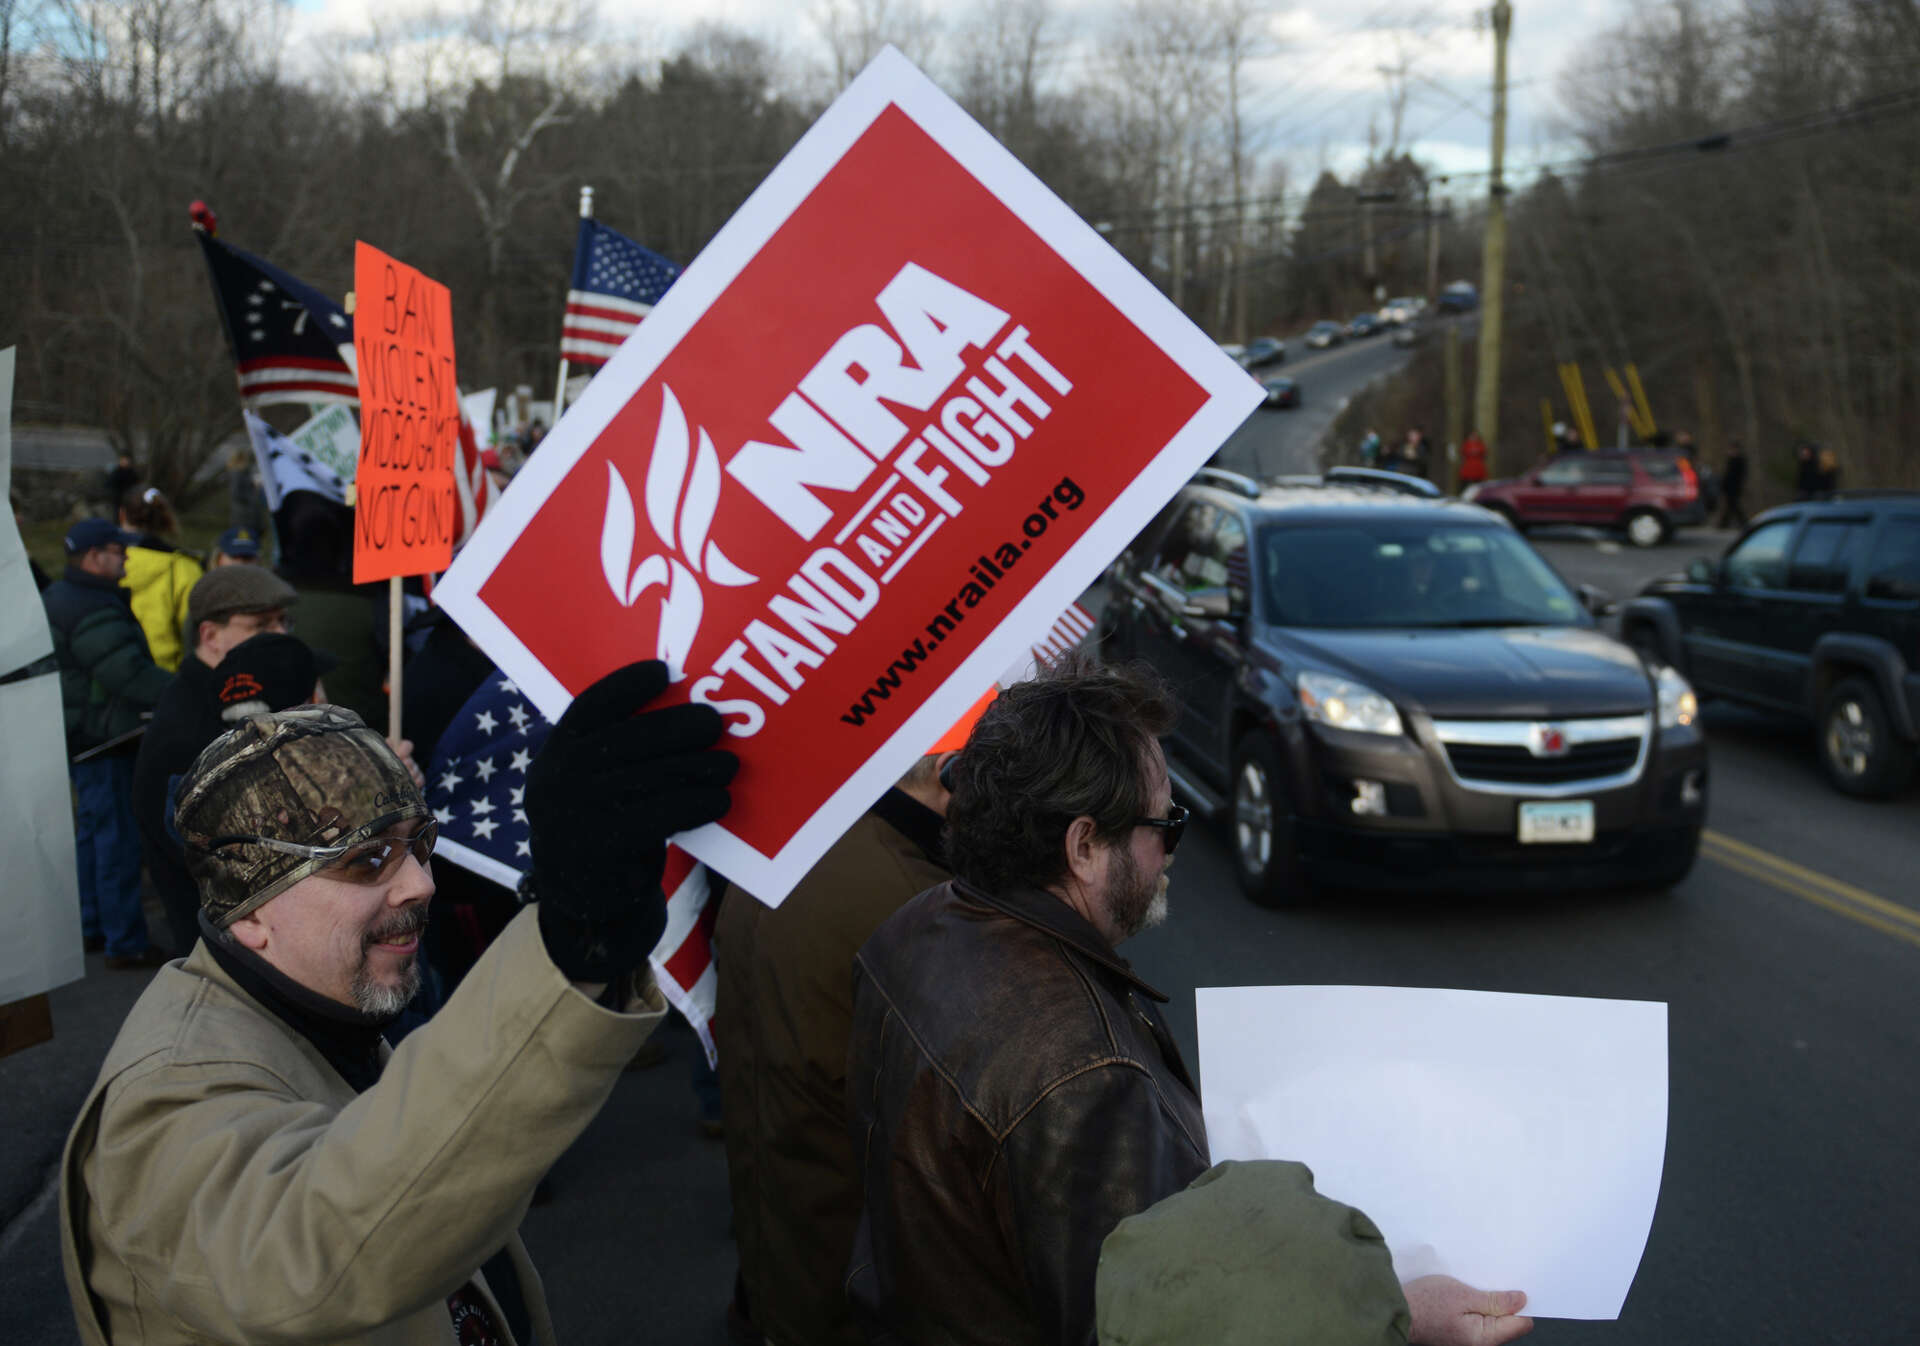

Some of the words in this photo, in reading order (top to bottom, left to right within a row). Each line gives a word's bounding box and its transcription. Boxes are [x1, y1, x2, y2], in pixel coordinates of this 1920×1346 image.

[360, 337, 452, 411] VIOLENT
[383, 263, 436, 348] BAN
[725, 261, 1011, 542] NRA
[356, 484, 401, 551] NOT
[689, 547, 880, 738] STAND
[857, 493, 927, 568] AND
[893, 325, 1074, 519] FIGHT
[840, 476, 1086, 727] www.nraila.org
